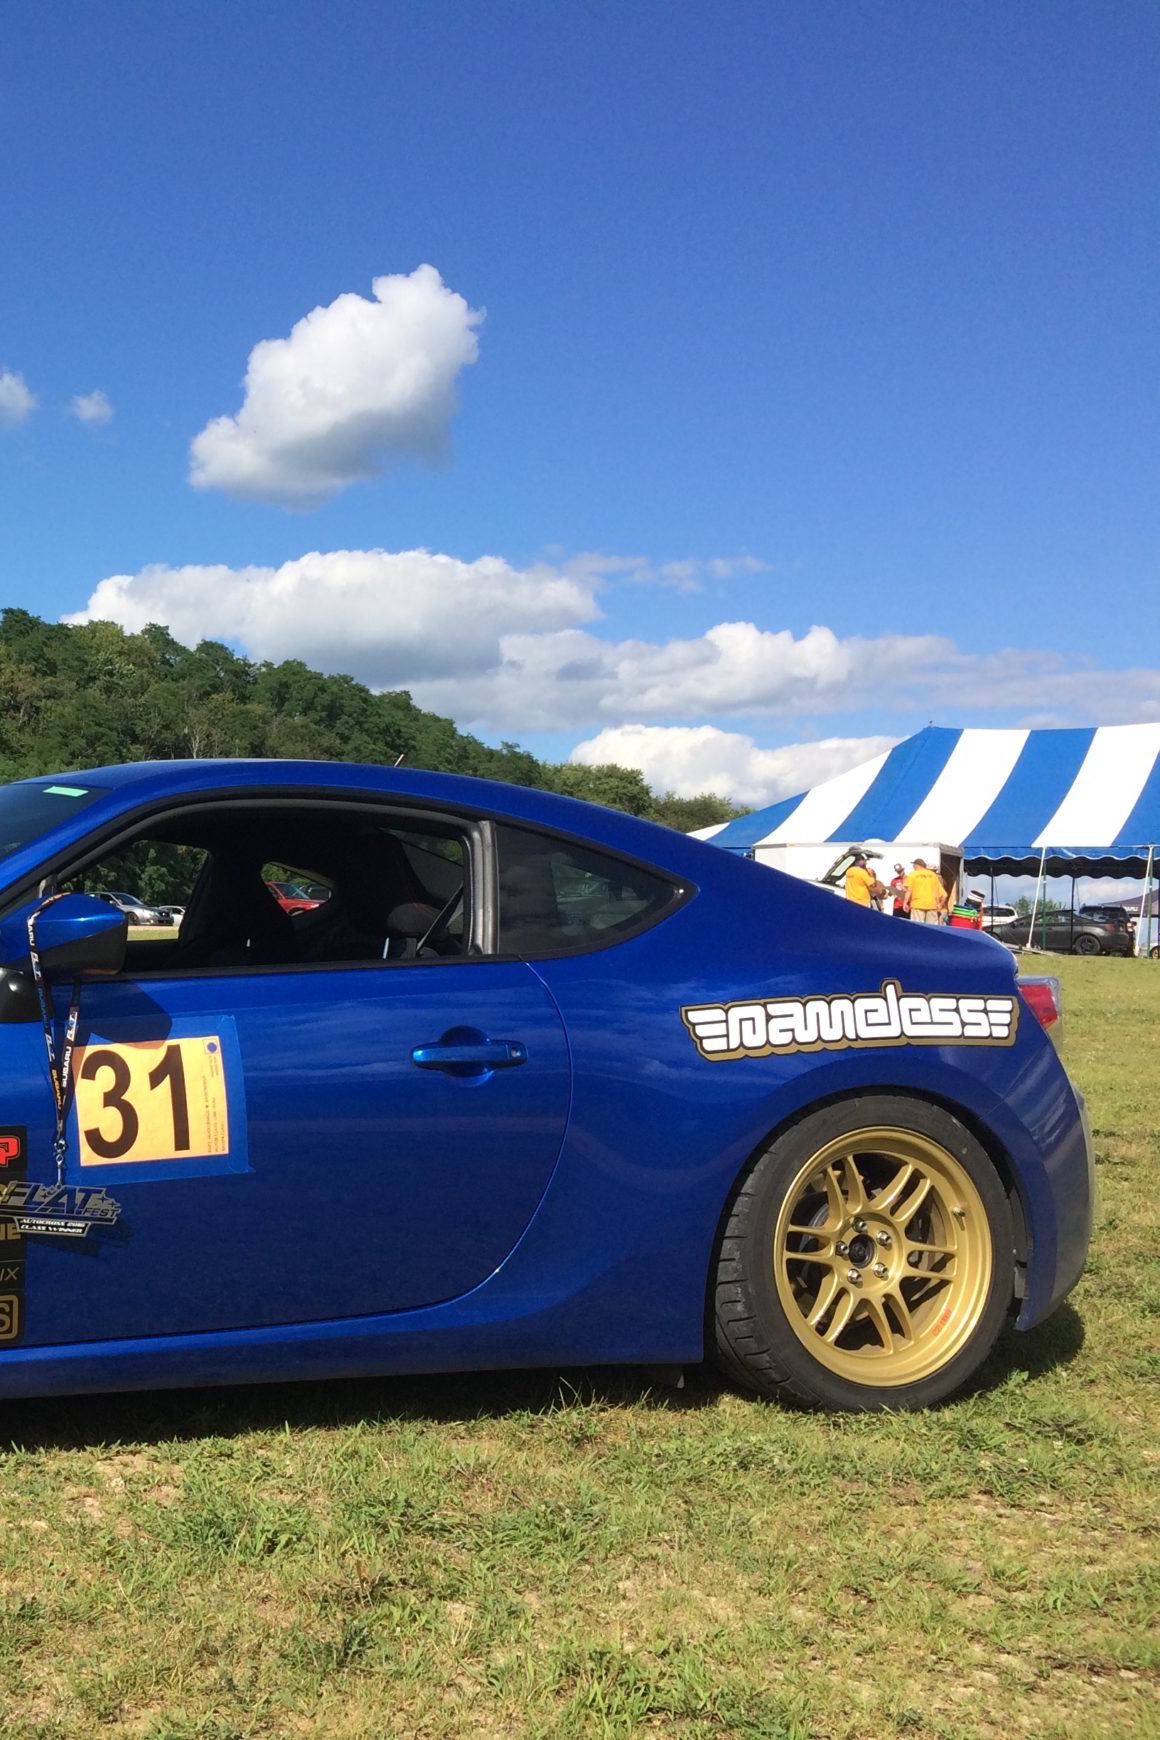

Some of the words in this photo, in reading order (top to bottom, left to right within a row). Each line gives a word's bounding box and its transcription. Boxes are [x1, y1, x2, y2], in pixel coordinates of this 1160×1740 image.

[61, 1046, 72, 1088] SUBARU
[81, 1044, 190, 1159] 31
[0, 1181, 106, 1215] FLAT
[20, 1218, 66, 1227] AUTOCROSS
[82, 1207, 120, 1217] FEST
[48, 1226, 84, 1234] WINNER
